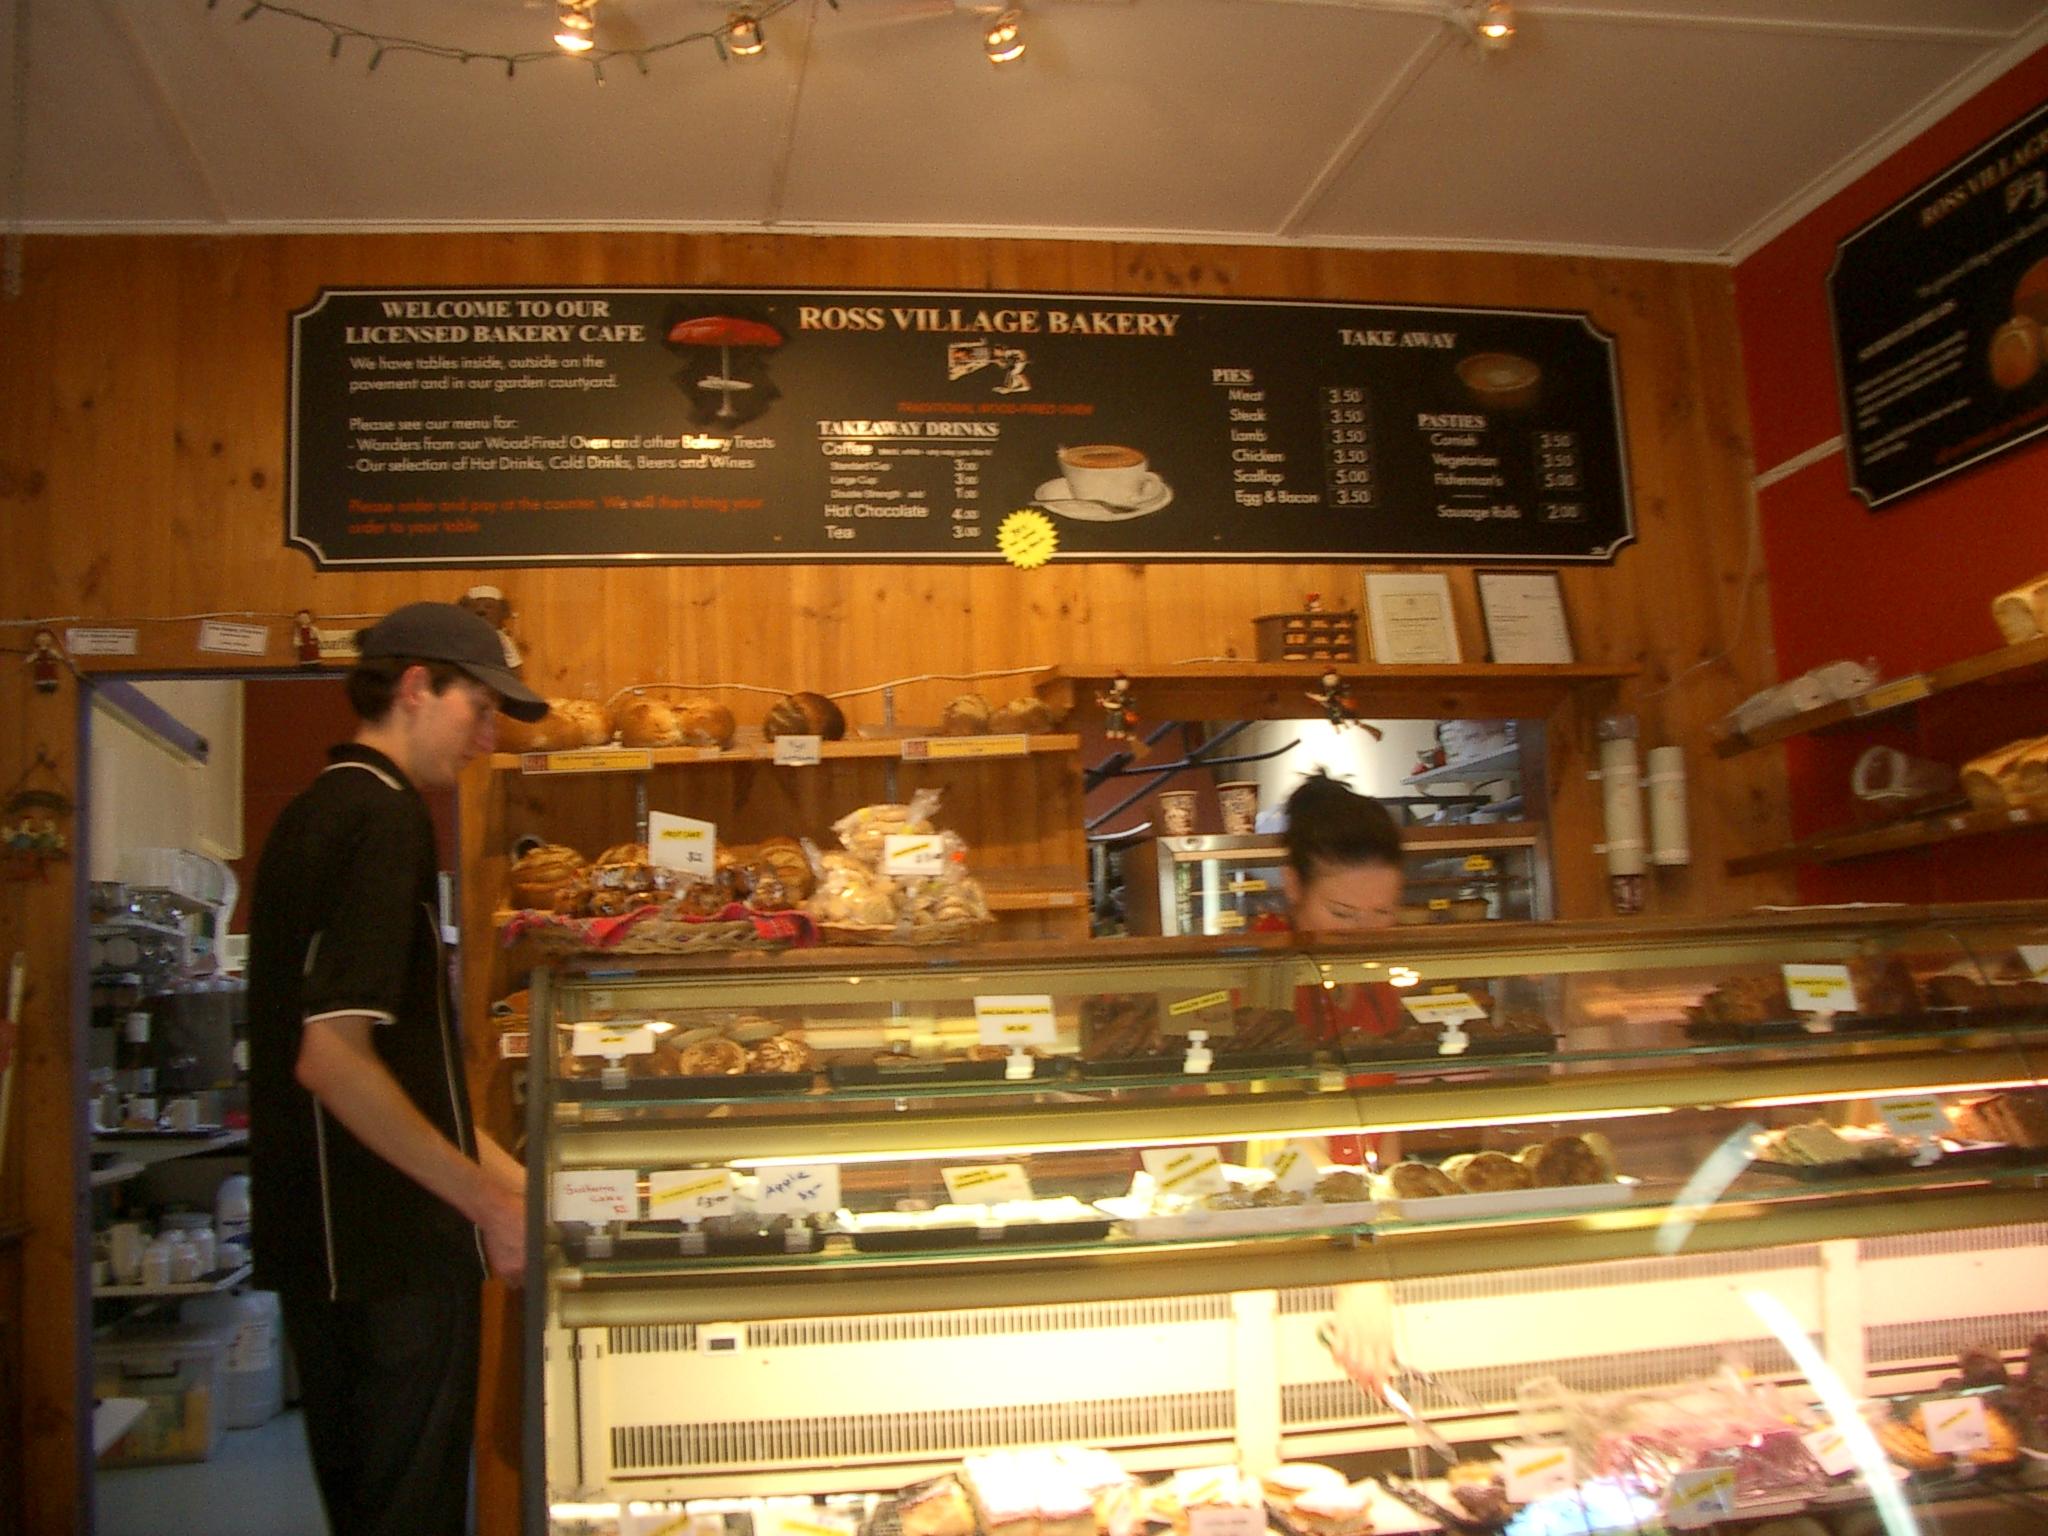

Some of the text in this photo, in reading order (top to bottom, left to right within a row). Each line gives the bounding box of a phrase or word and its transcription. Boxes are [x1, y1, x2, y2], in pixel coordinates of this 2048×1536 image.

[382, 299, 610, 319] WELCOME TO OUR
[799, 306, 1181, 337] ROSS VILLAGE BAKERY
[345, 324, 646, 345] LICENSED BAKERY CAFE
[1339, 329, 1458, 349] TAKE AWAY
[349, 357, 376, 370] We
[378, 356, 413, 370] have
[416, 356, 458, 370] tables
[508, 356, 558, 369] outside
[560, 358, 580, 369] on
[582, 356, 606, 369] the
[1212, 368, 1254, 383] PIES
[349, 377, 418, 393] pavement
[420, 376, 449, 390] and
[451, 376, 466, 390] in
[467, 378, 493, 390] our
[494, 376, 546, 392] garden
[1228, 389, 1265, 402] Meat
[1328, 389, 1362, 404] 3.50
[1229, 408, 1268, 422] Steak
[1330, 409, 1364, 424] 3.50
[1418, 414, 1487, 429] PASTIES
[349, 417, 395, 431] Please
[398, 419, 422, 431] see
[425, 419, 450, 431] our
[452, 419, 490, 430] menu
[817, 420, 1000, 437] TAKEAWAY DRINKS
[356, 437, 421, 451] Wonders
[423, 436, 455, 450] from
[458, 439, 483, 450] our
[569, 436, 610, 450] Oven
[612, 436, 640, 449] and
[642, 436, 679, 449] other
[681, 434, 732, 452] Bakery
[734, 436, 776, 449] Treats
[1231, 429, 1268, 442] Lamb
[1332, 429, 1366, 444] 3.50
[1431, 433, 1478, 447] Cornish
[821, 442, 874, 456] Coffee
[1232, 449, 1285, 463] Chicken
[1333, 449, 1368, 464] 3.50
[356, 458, 385, 472] Our
[387, 457, 449, 471] selection
[451, 457, 469, 471] of
[471, 457, 496, 470] Hot
[549, 456, 584, 470] Cold
[636, 456, 677, 469] Beers
[678, 455, 706, 469] and
[709, 455, 755, 469] Wines
[1432, 453, 1499, 468] Vegetarian
[1233, 469, 1285, 485] Scallop
[1335, 469, 1369, 484] 5.00
[1234, 490, 1320, 507] Egg & Bacon
[1337, 489, 1371, 505] 3.50
[824, 504, 929, 518] Hot Chocolate
[1437, 505, 1520, 520] Sausage Rolls
[824, 525, 856, 539] Tea
